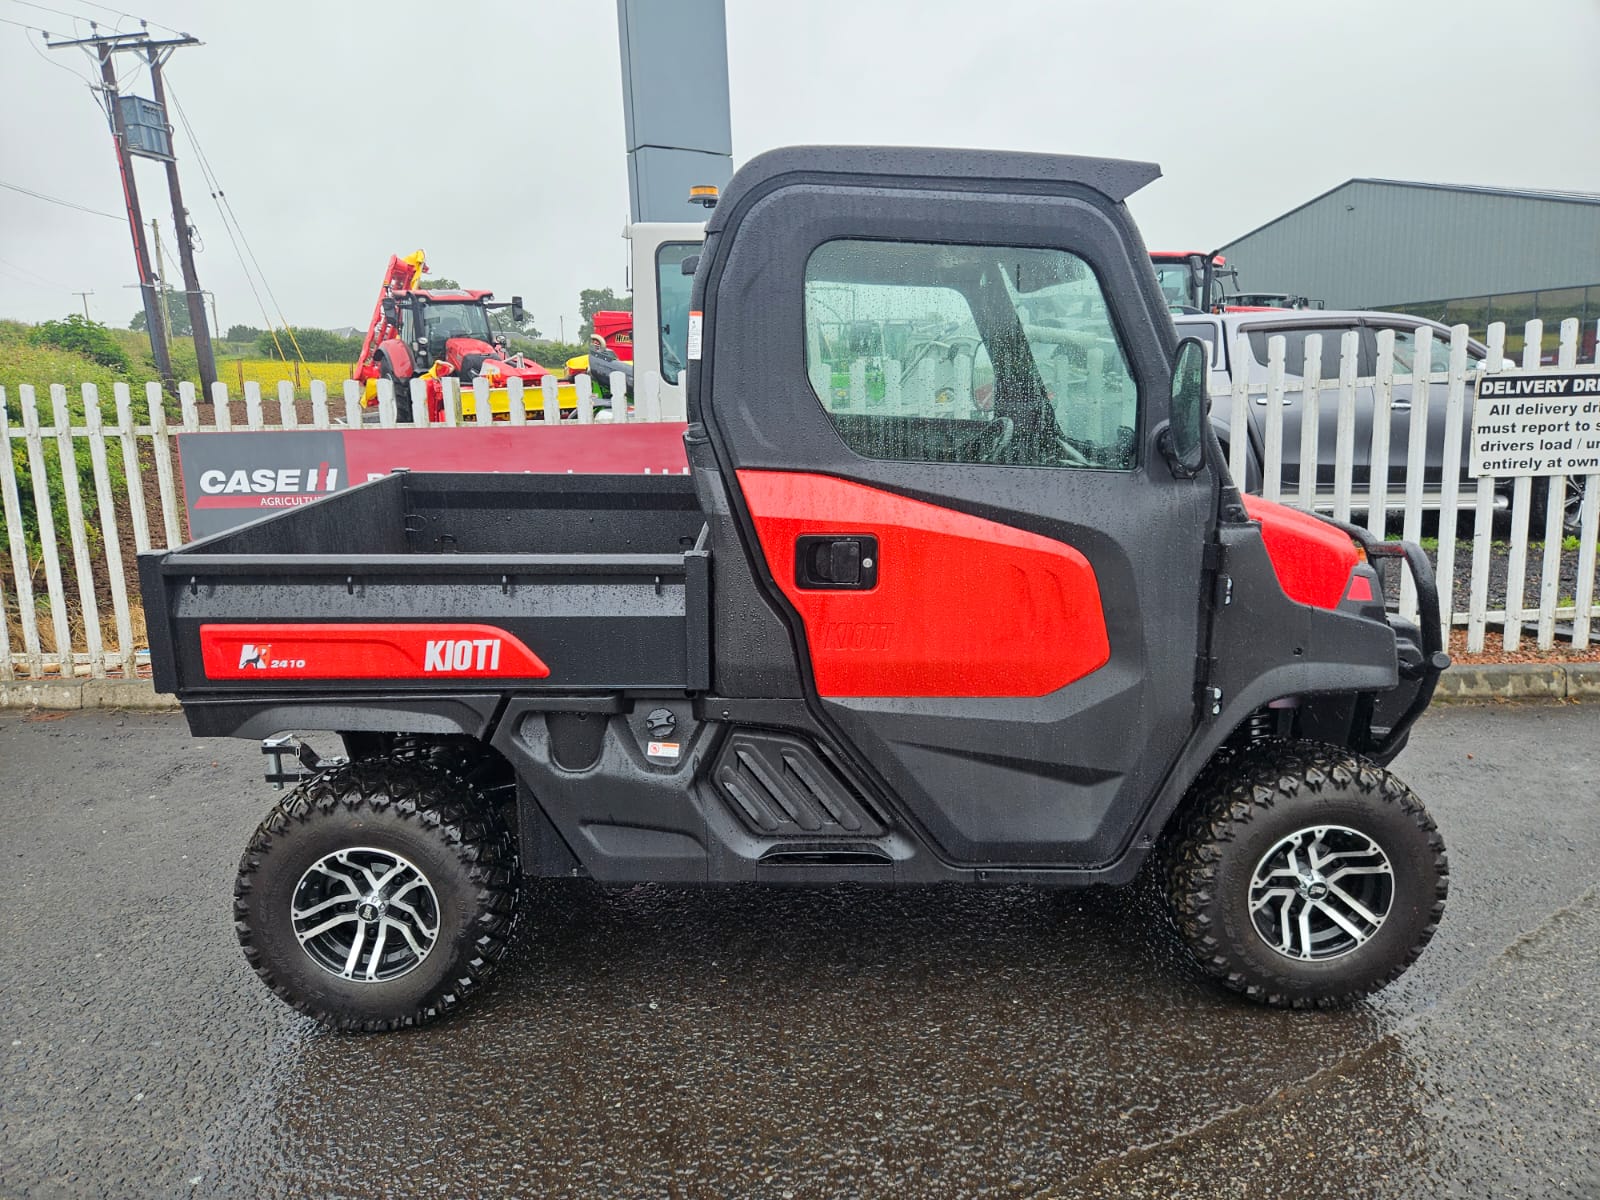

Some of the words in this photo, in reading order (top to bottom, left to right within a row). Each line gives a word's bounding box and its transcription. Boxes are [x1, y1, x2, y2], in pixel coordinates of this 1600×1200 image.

[1481, 379, 1569, 395] DELIVERY
[1489, 404, 1510, 416] All
[1515, 403, 1578, 417] delivery
[1477, 422, 1517, 434] must
[1521, 421, 1570, 435] report
[1575, 420, 1591, 432] to
[1480, 441, 1535, 452] drivers
[1539, 438, 1573, 450] load
[1482, 457, 1542, 471] entirely
[1547, 457, 1562, 468] at
[1567, 458, 1599, 468] own
[199, 469, 301, 494] CASE
[260, 496, 322, 506] AGRICULT
[424, 639, 501, 672] KIOTI
[270, 659, 306, 669] 2410
